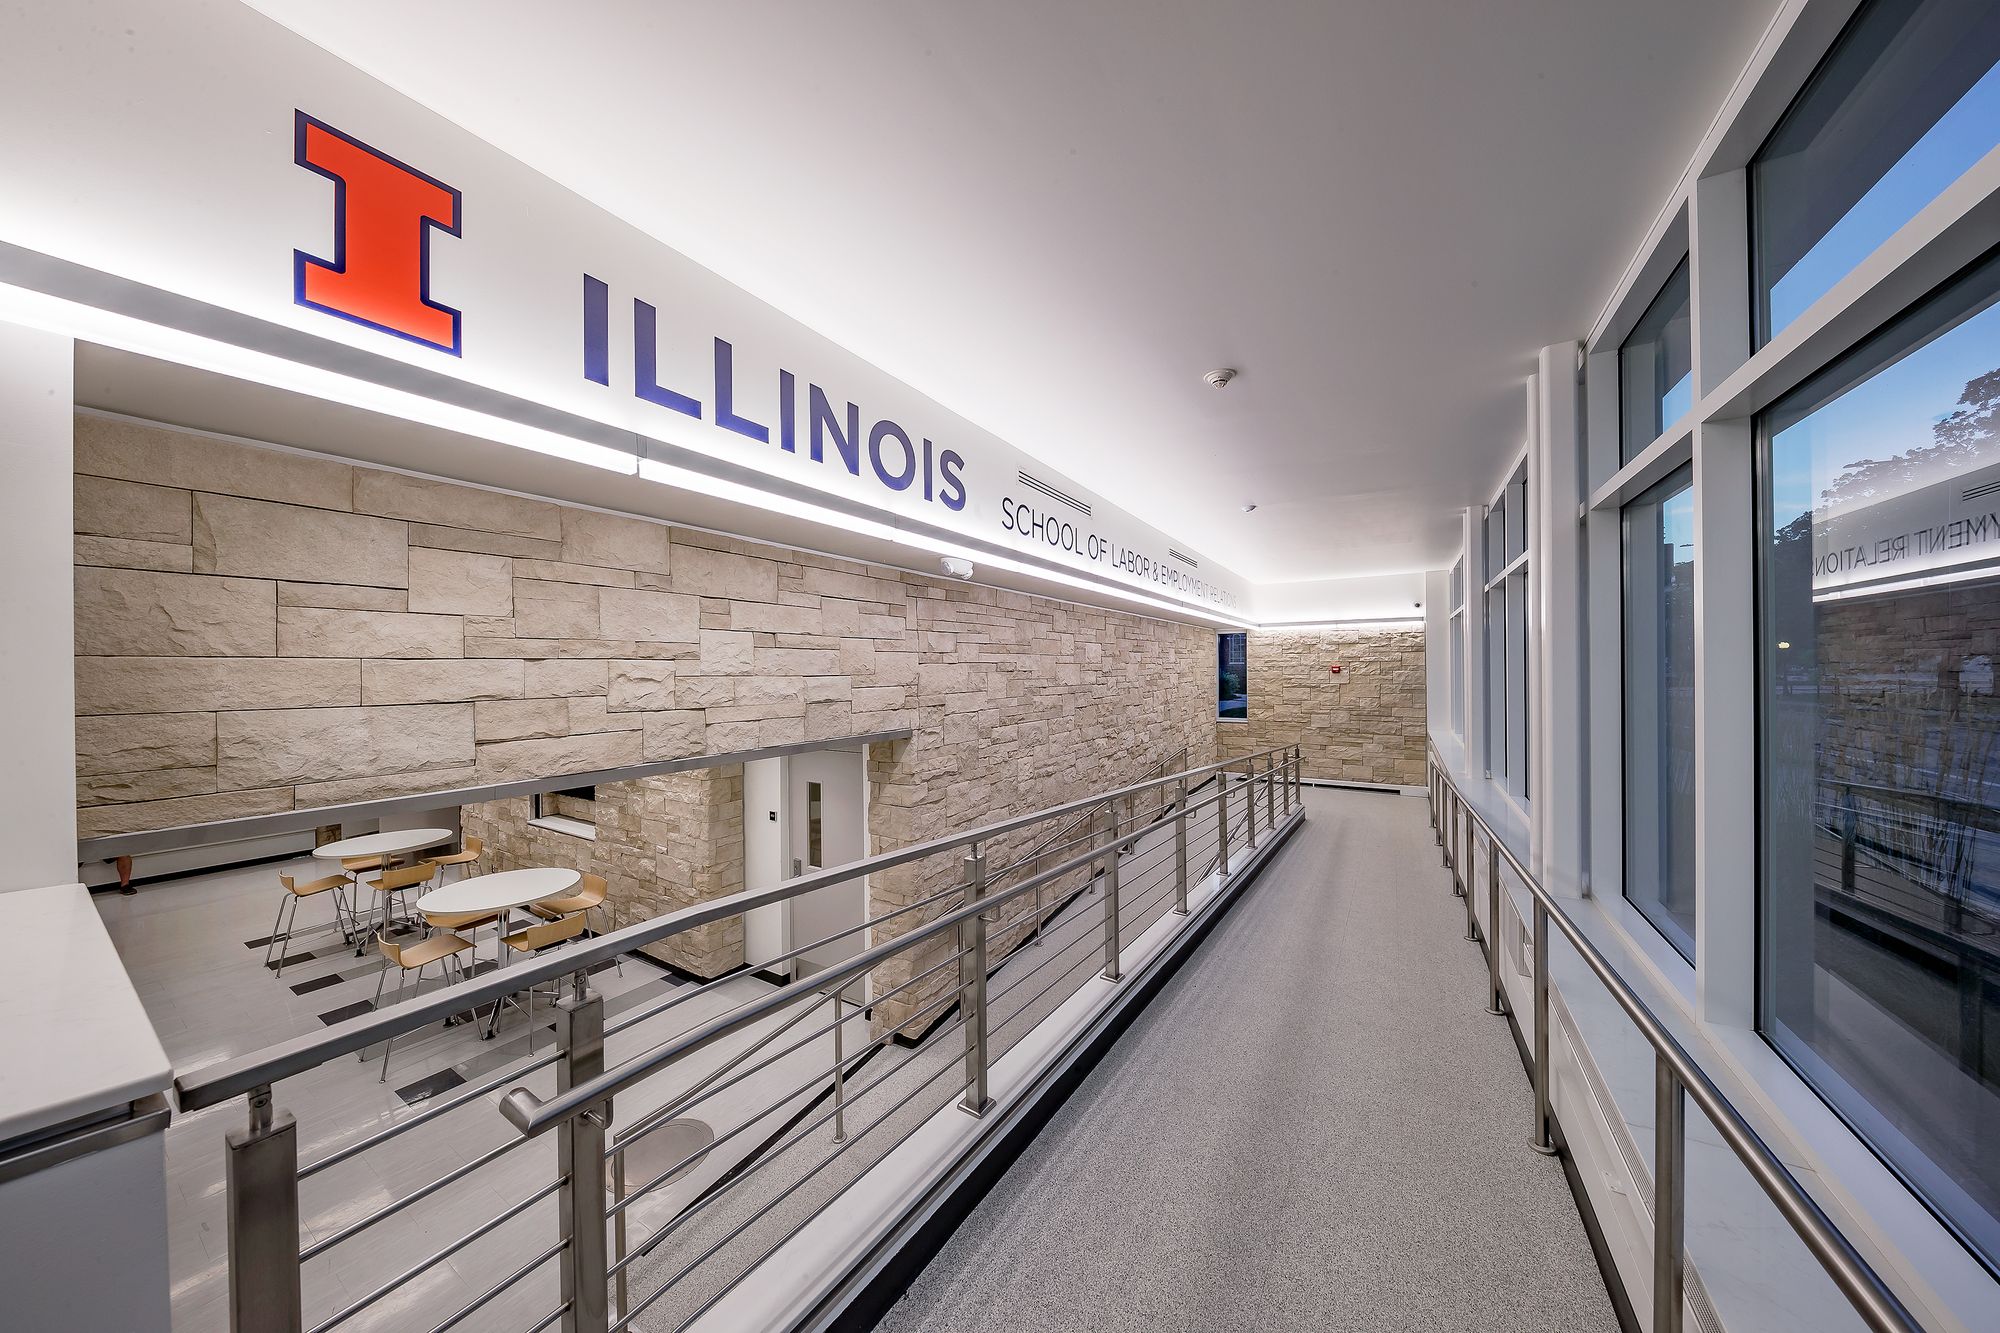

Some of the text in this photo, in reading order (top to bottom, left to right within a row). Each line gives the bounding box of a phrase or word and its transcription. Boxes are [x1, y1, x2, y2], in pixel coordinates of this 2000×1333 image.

[294, 108, 967, 512] I ILLINOIS
[1001, 496, 1083, 556] SCHOOL
[1087, 534, 1107, 562] OF
[1111, 543, 1150, 579] LABOR
[1152, 561, 1159, 582] &
[1161, 564, 1209, 598] EMPLOYMENT
